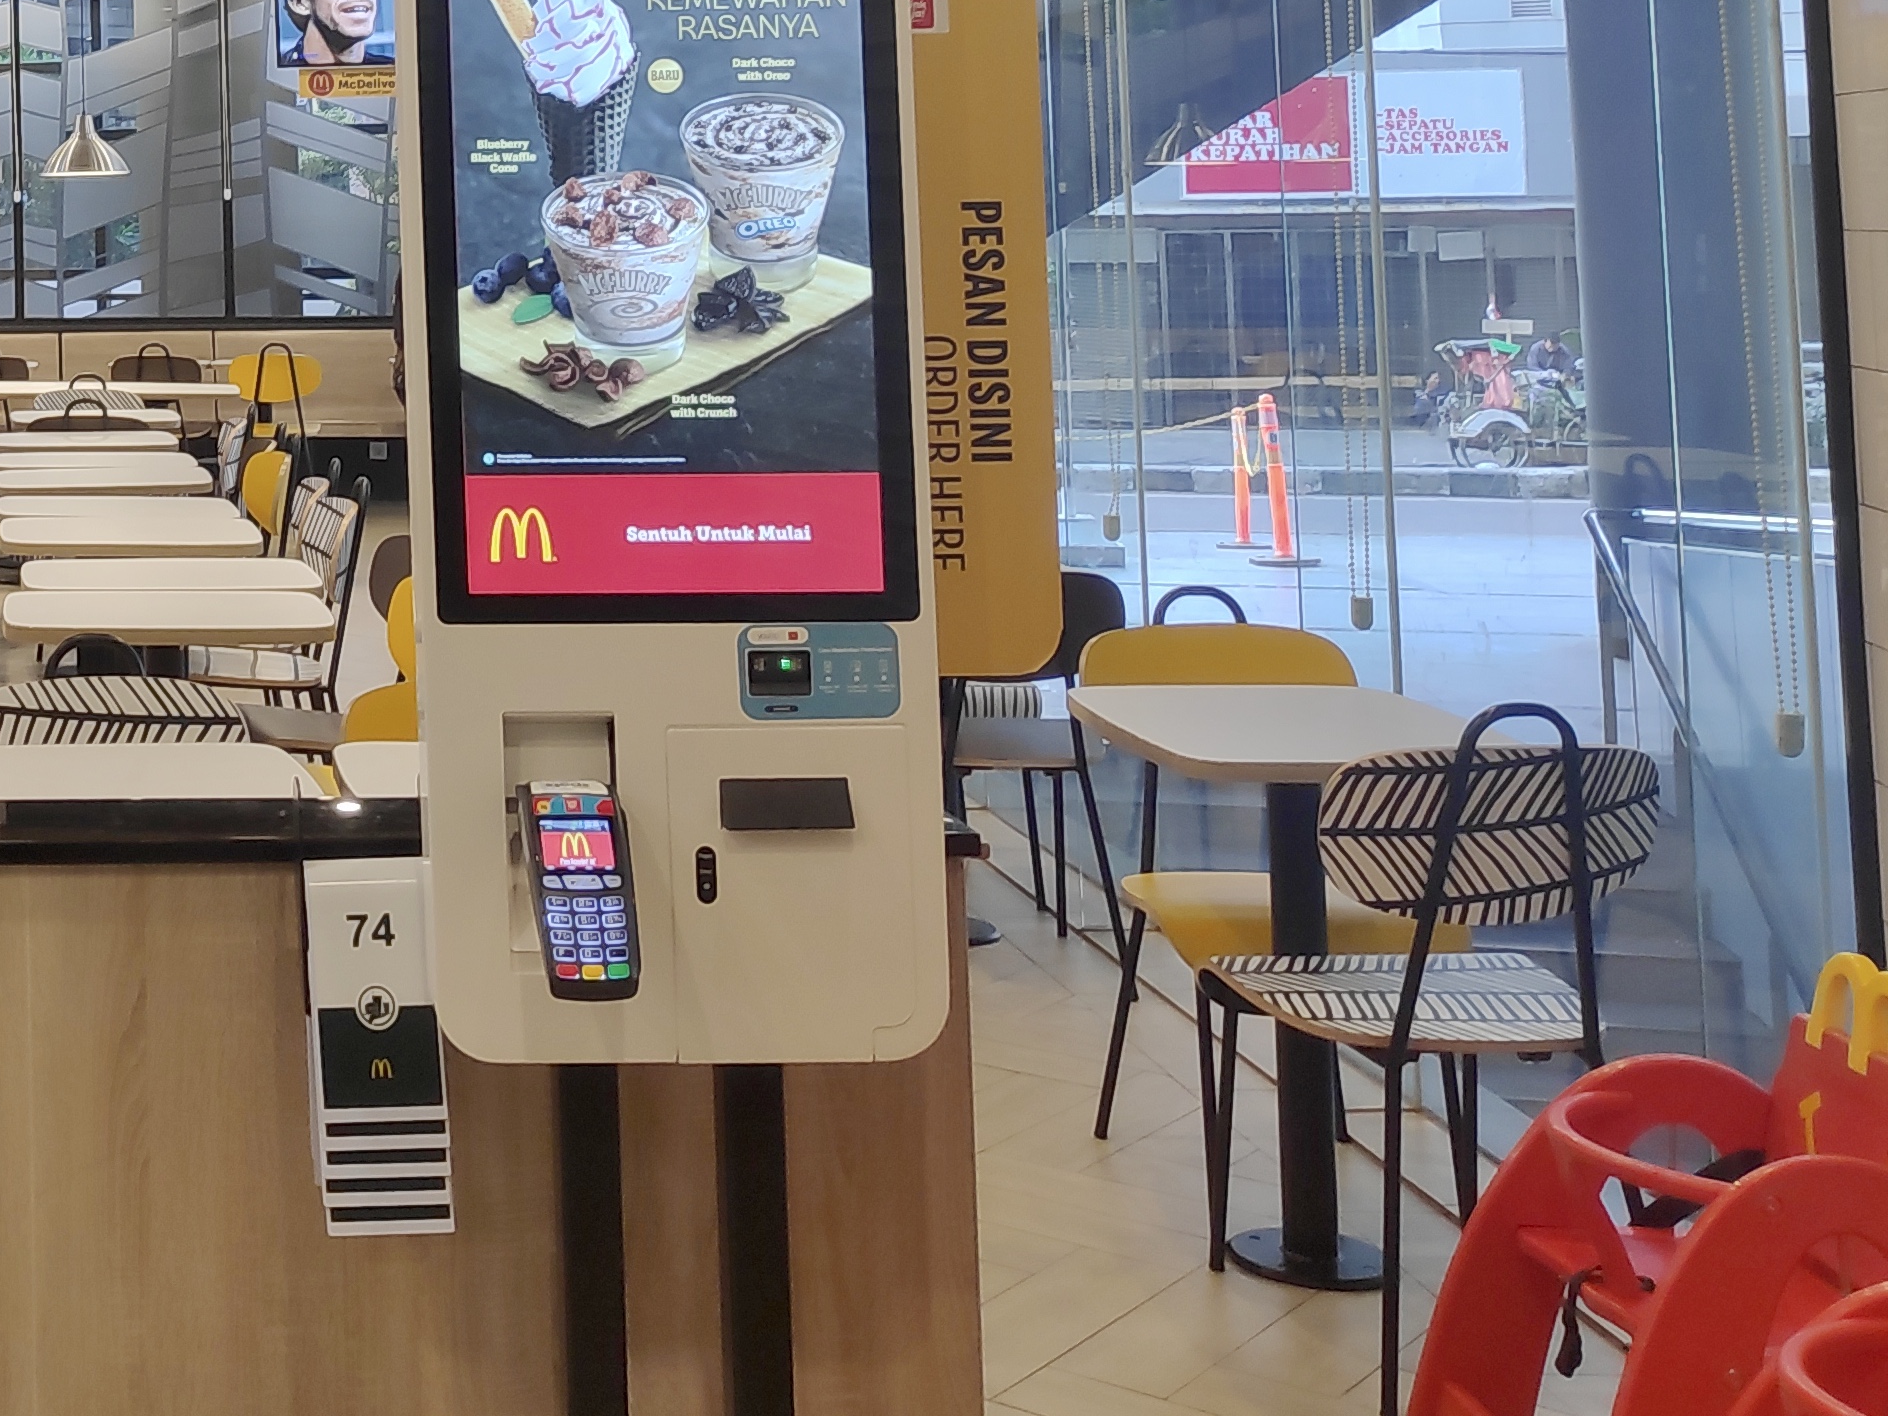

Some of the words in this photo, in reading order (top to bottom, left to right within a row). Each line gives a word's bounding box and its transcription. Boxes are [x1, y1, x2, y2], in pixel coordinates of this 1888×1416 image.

[678, 14, 819, 41] RASANYA
[732, 58, 758, 68] Dark
[760, 58, 795, 67] Choco
[651, 69, 680, 81] BARU
[738, 71, 762, 81] with
[476, 139, 530, 151] Blueberry
[1206, 127, 1280, 145] URAH
[1189, 142, 1340, 162] KEPATIHAN
[1430, 141, 1509, 154] TANGAN
[470, 152, 501, 163] Black
[738, 217, 795, 237] OREO
[960, 200, 1007, 327] PESAN
[671, 394, 698, 405] Dark
[699, 393, 735, 404] Choco
[924, 335, 961, 464] ORDER
[966, 339, 1013, 462] DISINI
[670, 408, 695, 418] with
[696, 407, 737, 418] Crunch
[929, 475, 966, 572] HERE
[626, 526, 693, 543] Sentuh
[695, 525, 755, 542] Untuk
[758, 525, 812, 541] Mulai
[345, 913, 396, 947] 74
